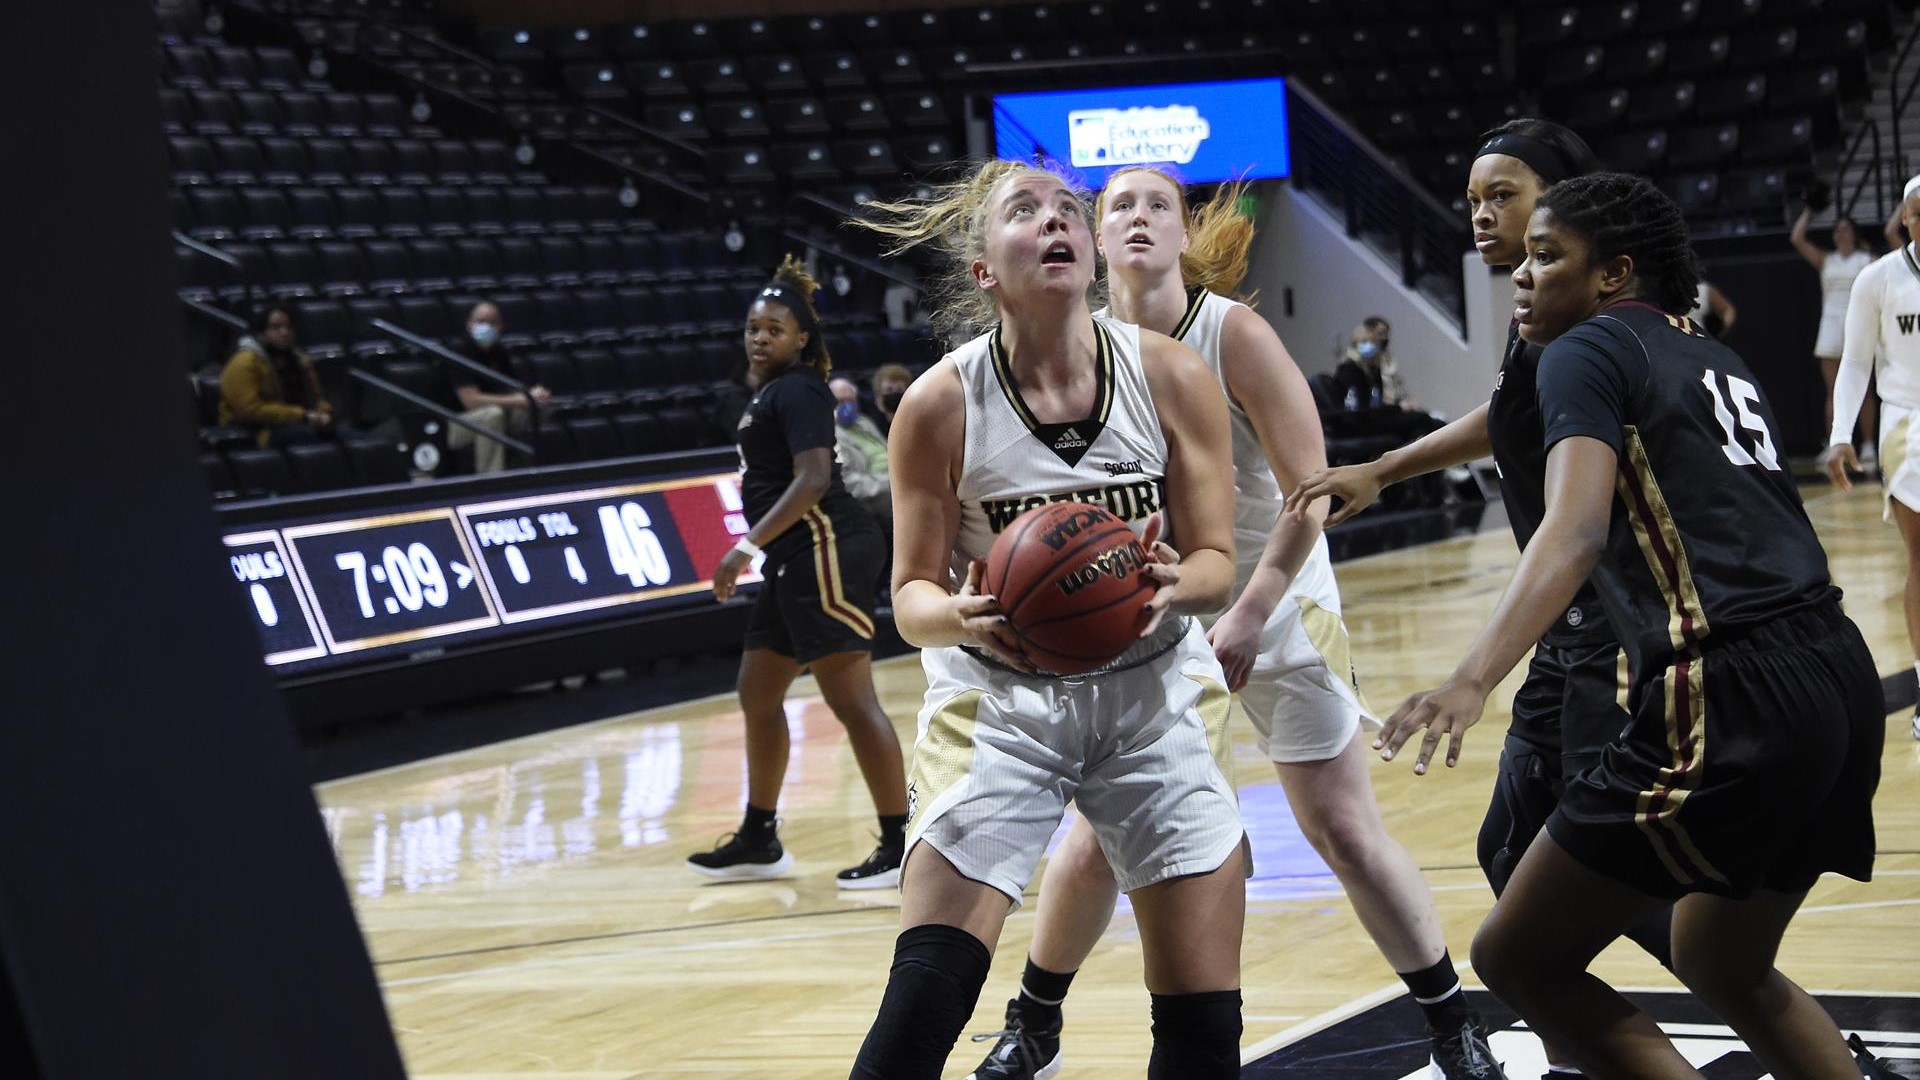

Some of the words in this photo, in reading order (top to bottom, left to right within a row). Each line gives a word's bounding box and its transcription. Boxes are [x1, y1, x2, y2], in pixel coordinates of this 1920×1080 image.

[1109, 123, 1202, 141] Education
[1110, 141, 1192, 160] Lottery
[1701, 369, 1782, 471] 15
[1054, 439, 1087, 449] adidas
[1104, 460, 1144, 477] SOCON
[474, 516, 538, 547] FOULS
[597, 501, 671, 587] 46
[1040, 509, 1114, 550] NCAA
[335, 542, 449, 618] 7:09
